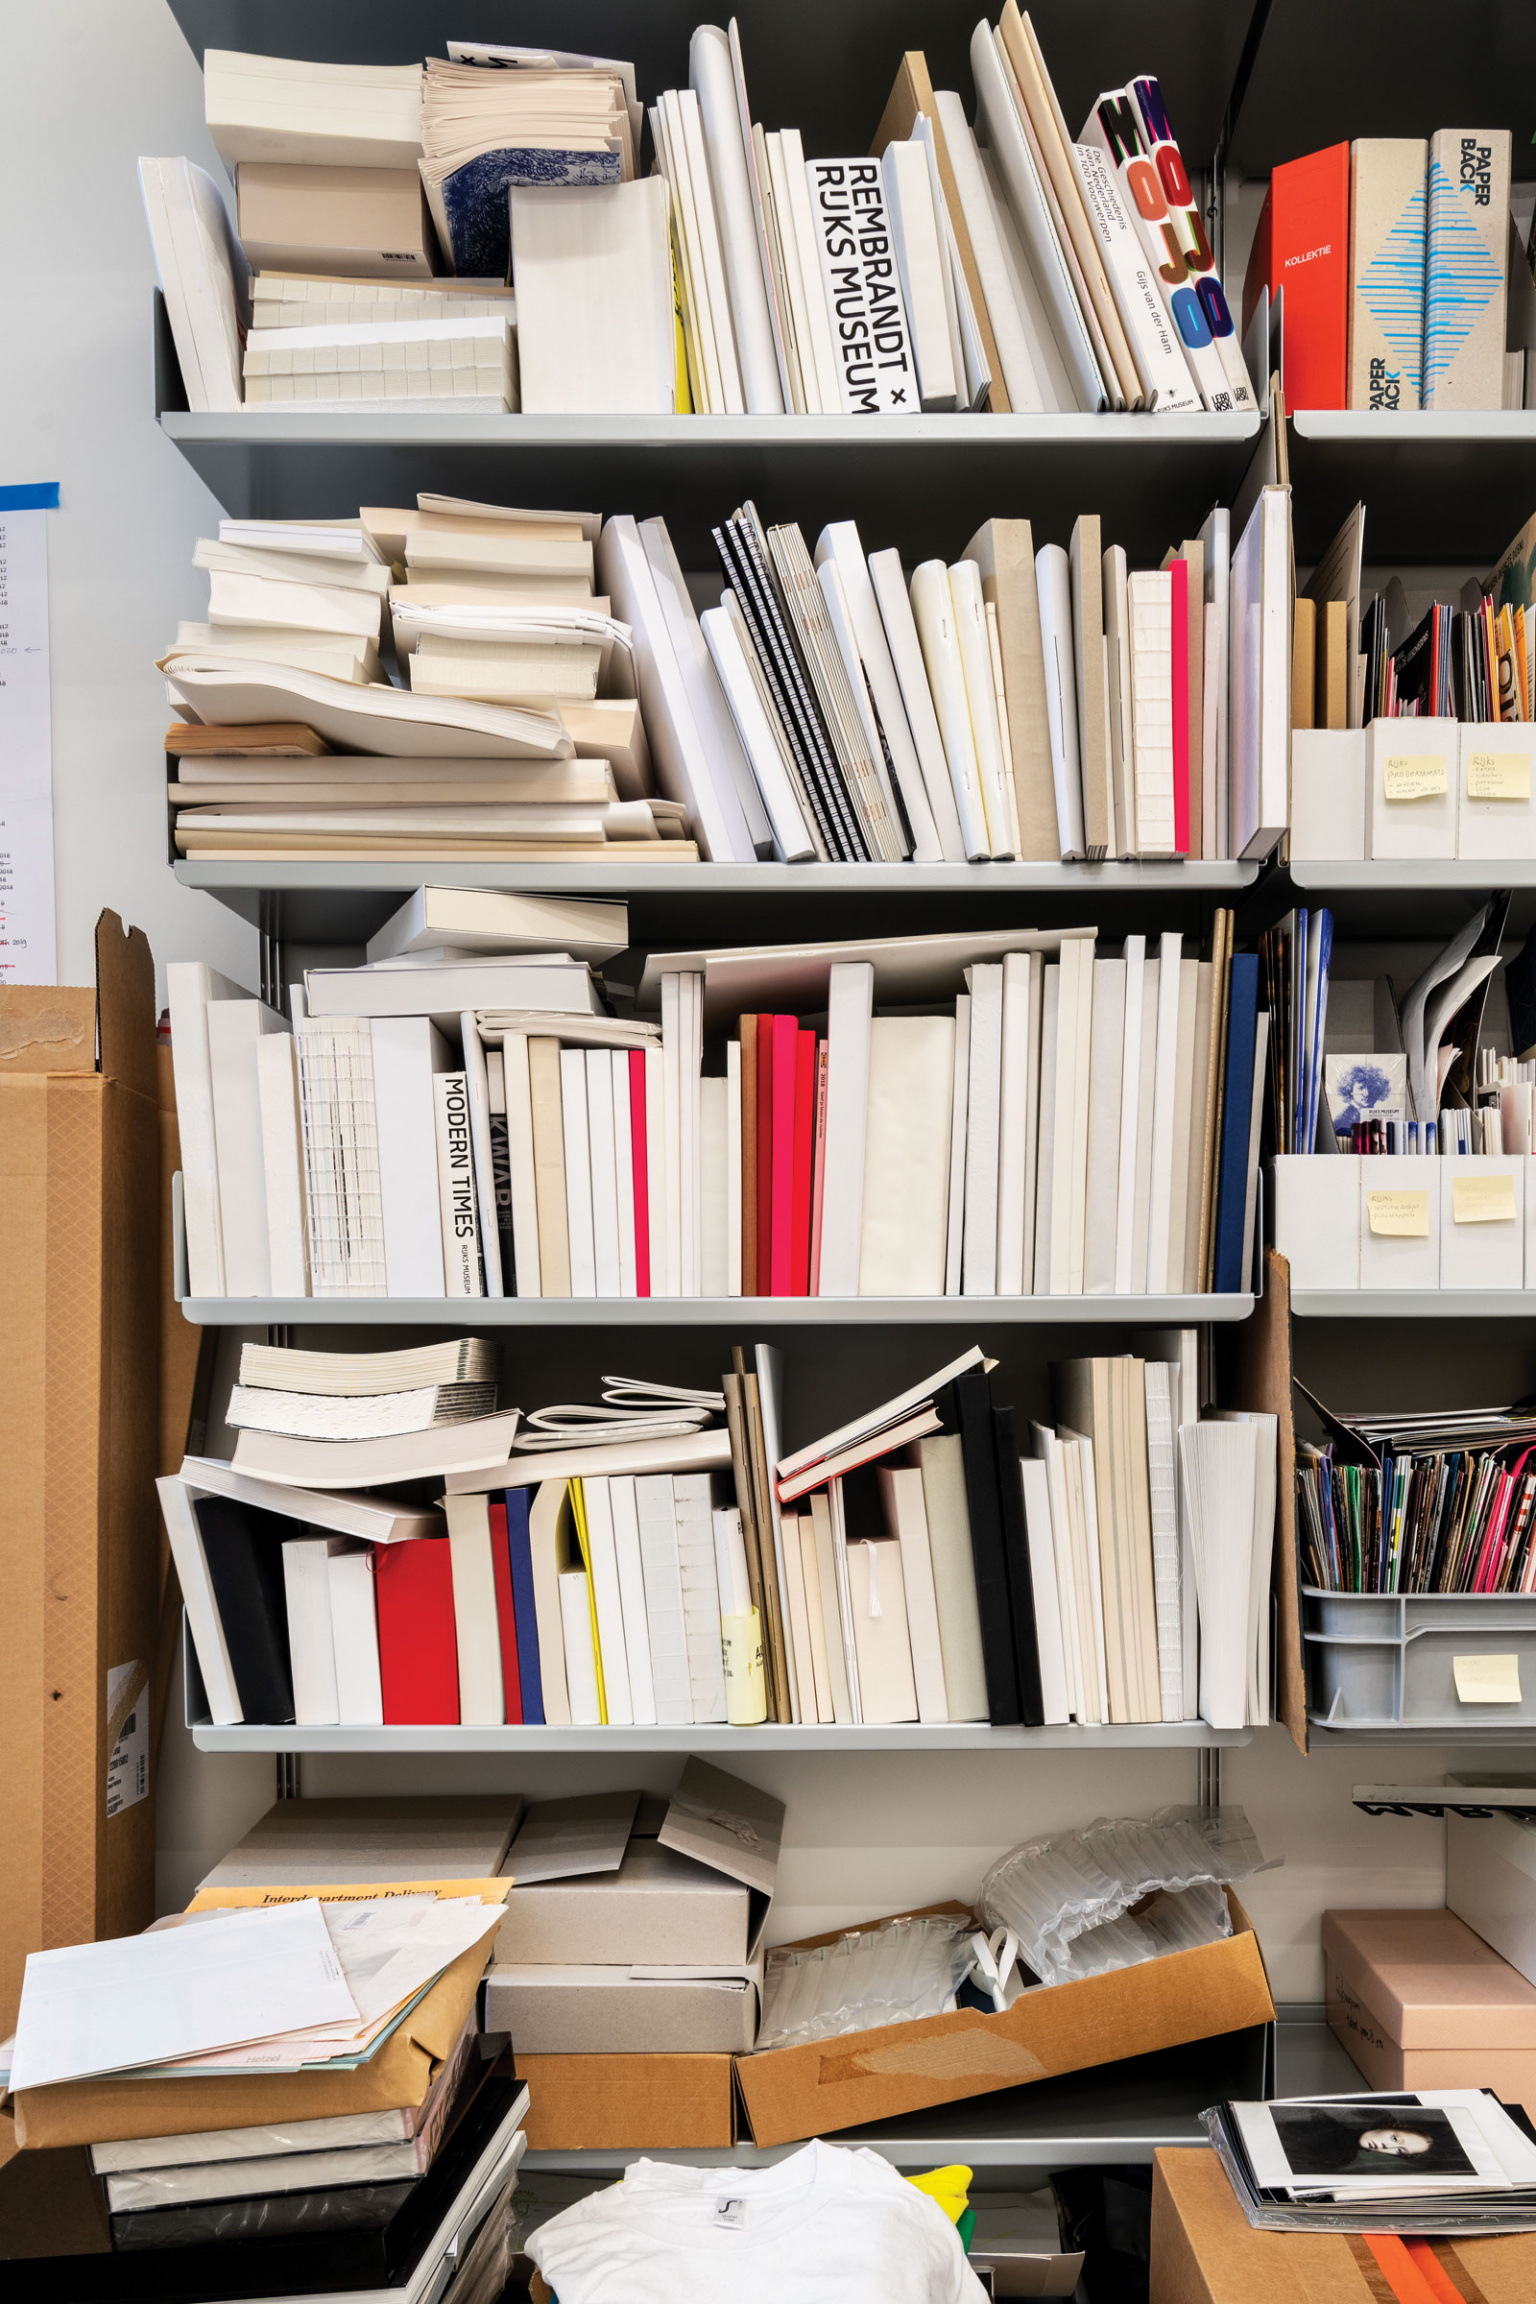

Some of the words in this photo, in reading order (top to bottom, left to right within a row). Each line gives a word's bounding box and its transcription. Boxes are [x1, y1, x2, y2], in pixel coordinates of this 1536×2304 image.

[1077, 146, 1085, 157] in
[1081, 160, 1092, 178] 100
[1087, 181, 1112, 243] voorwerpen
[1085, 148, 1095, 167] van
[1091, 170, 1116, 221] Nederland
[1093, 150, 1102, 164] De
[1098, 167, 1127, 230] Geschiedenis
[1460, 138, 1477, 193] BACK
[1474, 146, 1492, 206] PAPER
[816, 165, 856, 257] RIJKS
[849, 165, 908, 372] REMBRANDT
[1284, 245, 1331, 268] KOLLEKTIE
[830, 267, 881, 413] MUSEUM
[1136, 270, 1149, 290] Gijs
[1144, 291, 1156, 309] van
[1151, 311, 1163, 328] der
[1158, 330, 1172, 355] Ham
[1172, 399, 1194, 410] MUSEUM
[1369, 357, 1385, 410] PAPER
[1384, 371, 1400, 410] ACK
[445, 1078, 470, 1169] MODERN
[452, 1176, 474, 1239] TIMES
[461, 1244, 469, 1263] RIJKS
[462, 1264, 471, 1295] MUSEUM
[262, 1893, 378, 1904] Interdpartment
